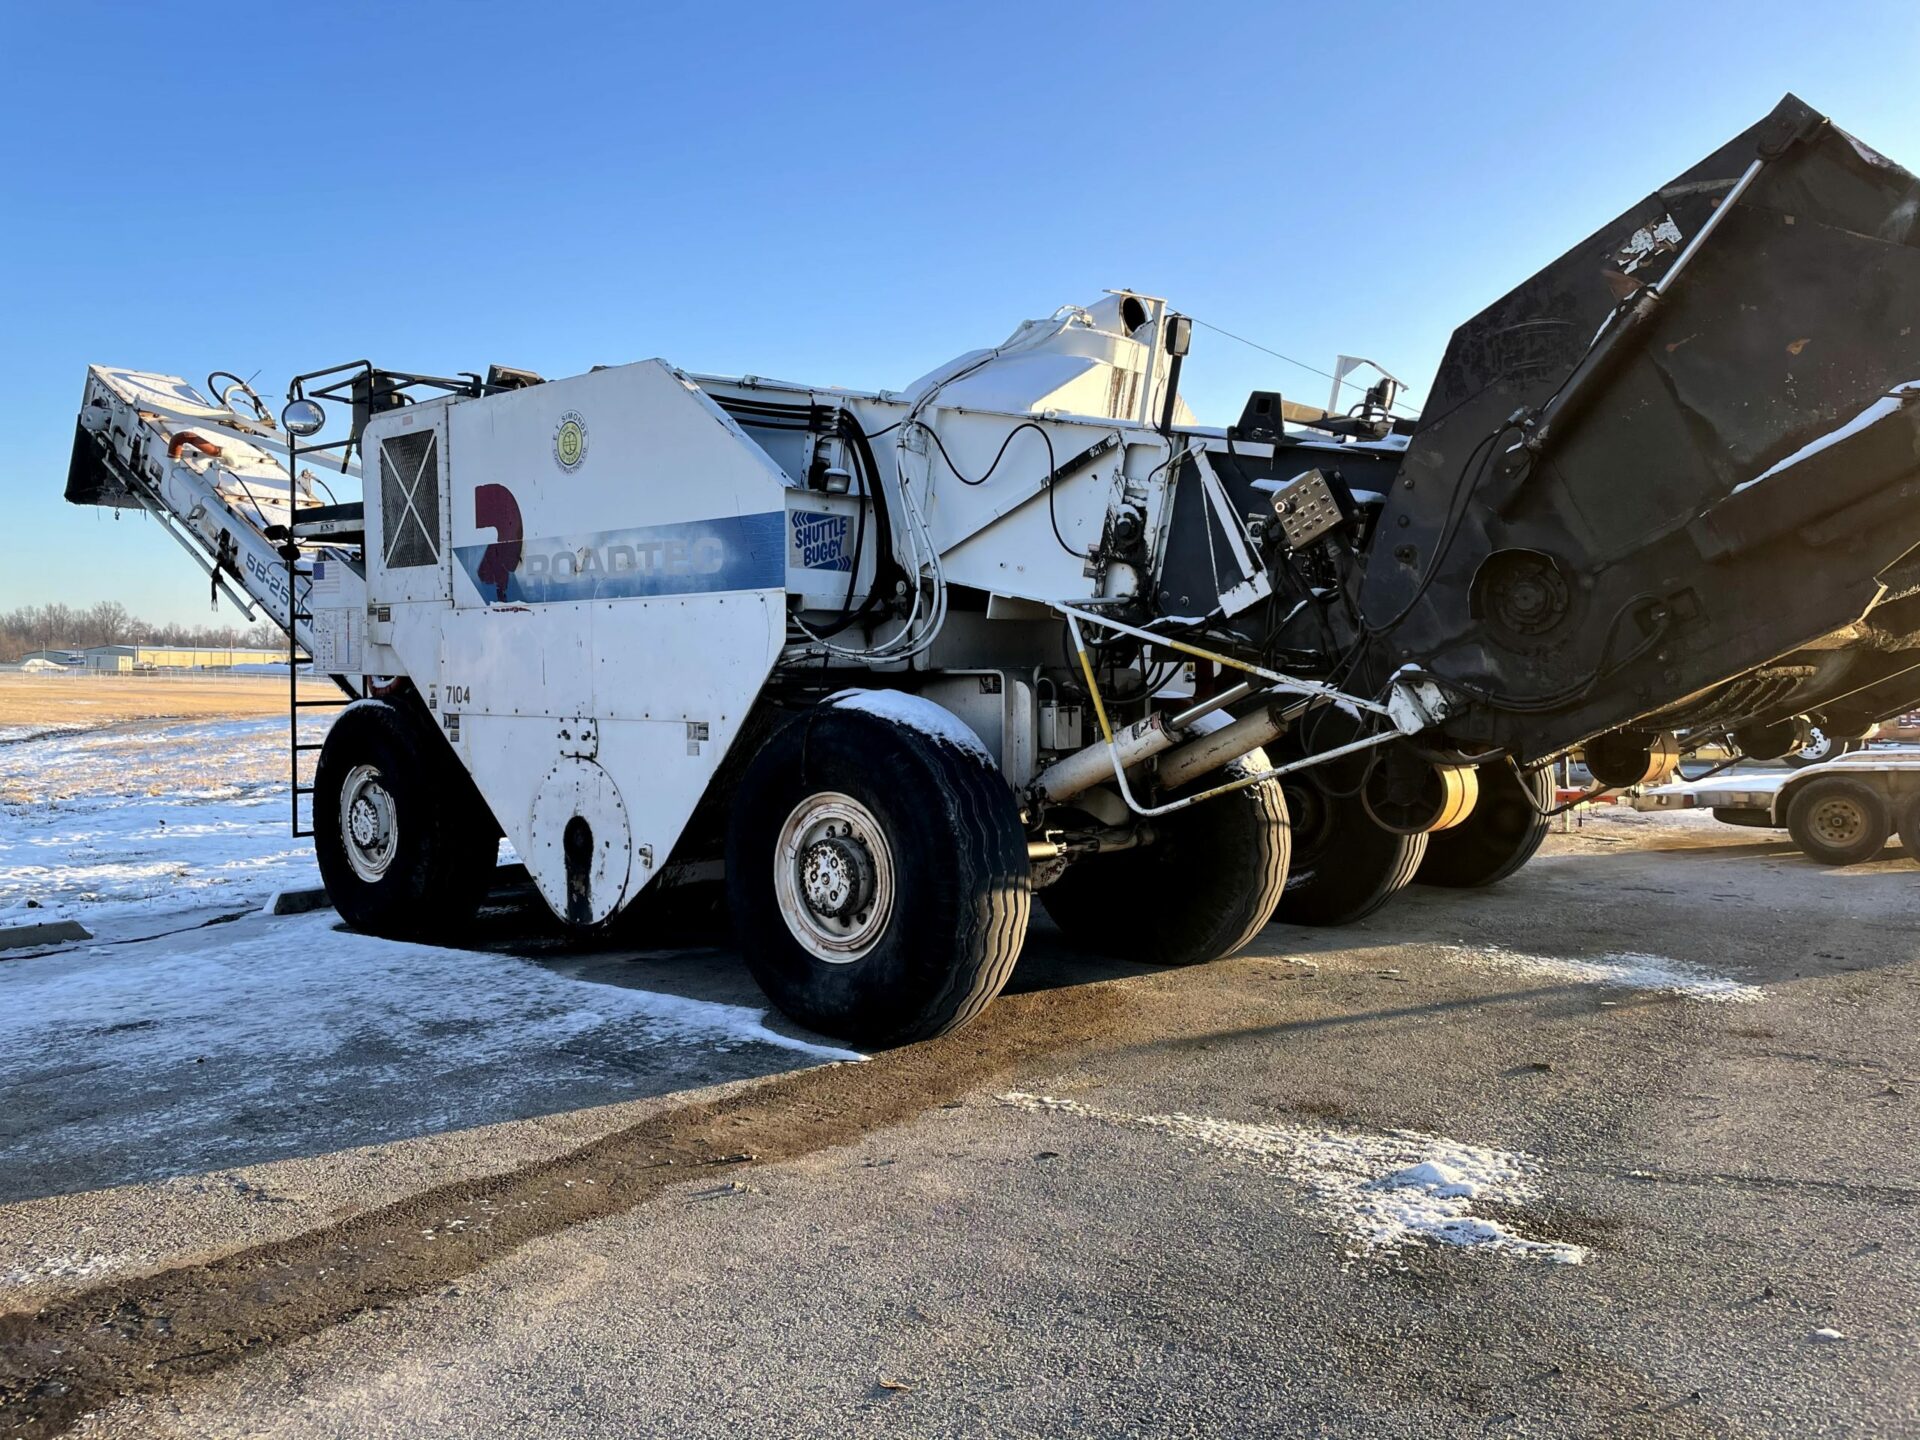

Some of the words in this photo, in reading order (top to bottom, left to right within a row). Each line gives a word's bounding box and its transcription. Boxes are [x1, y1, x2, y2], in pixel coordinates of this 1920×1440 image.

[795, 516, 847, 549] SHUTTLE
[526, 537, 724, 586] ROADTEC
[804, 536, 843, 567] BUGGY
[446, 685, 470, 704] 7104
